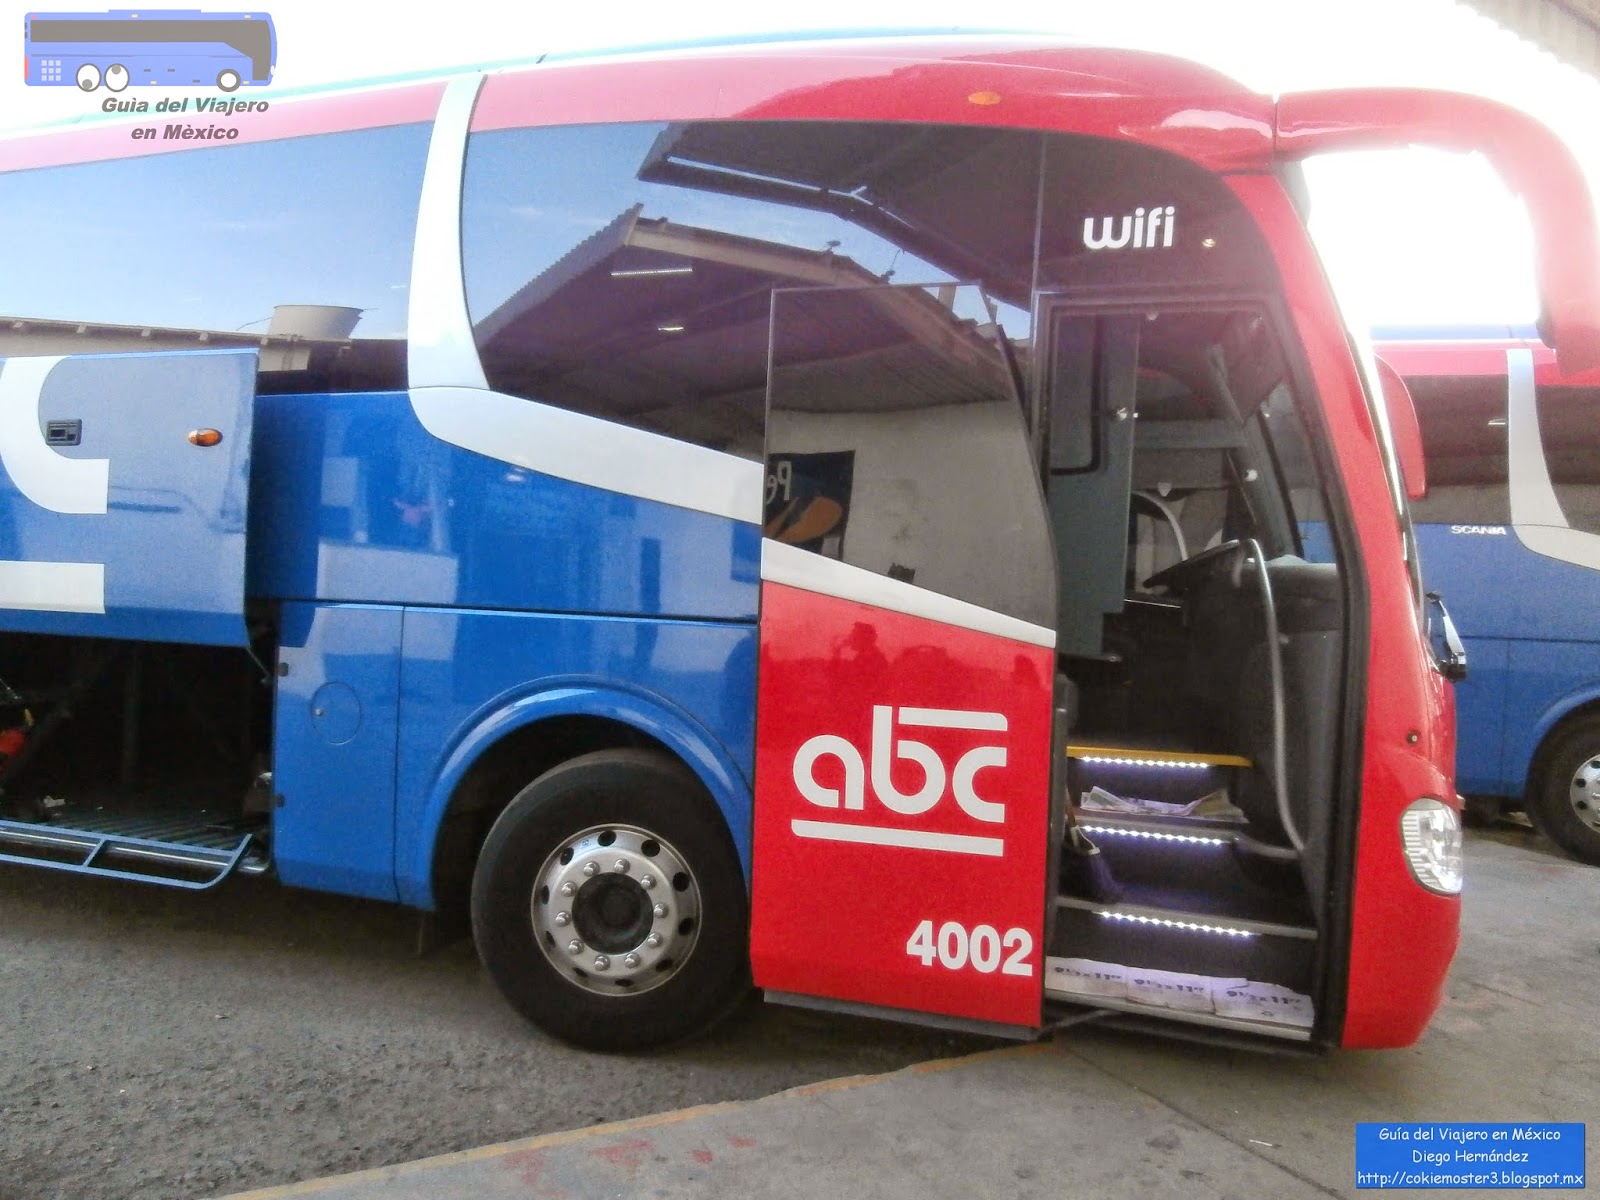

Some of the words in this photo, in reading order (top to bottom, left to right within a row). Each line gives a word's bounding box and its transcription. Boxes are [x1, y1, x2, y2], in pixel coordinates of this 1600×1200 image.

[1083, 206, 1175, 249] wifi
[1451, 525, 1507, 536] SCANIA
[793, 705, 1007, 823] abc
[906, 920, 1033, 977] 4002
